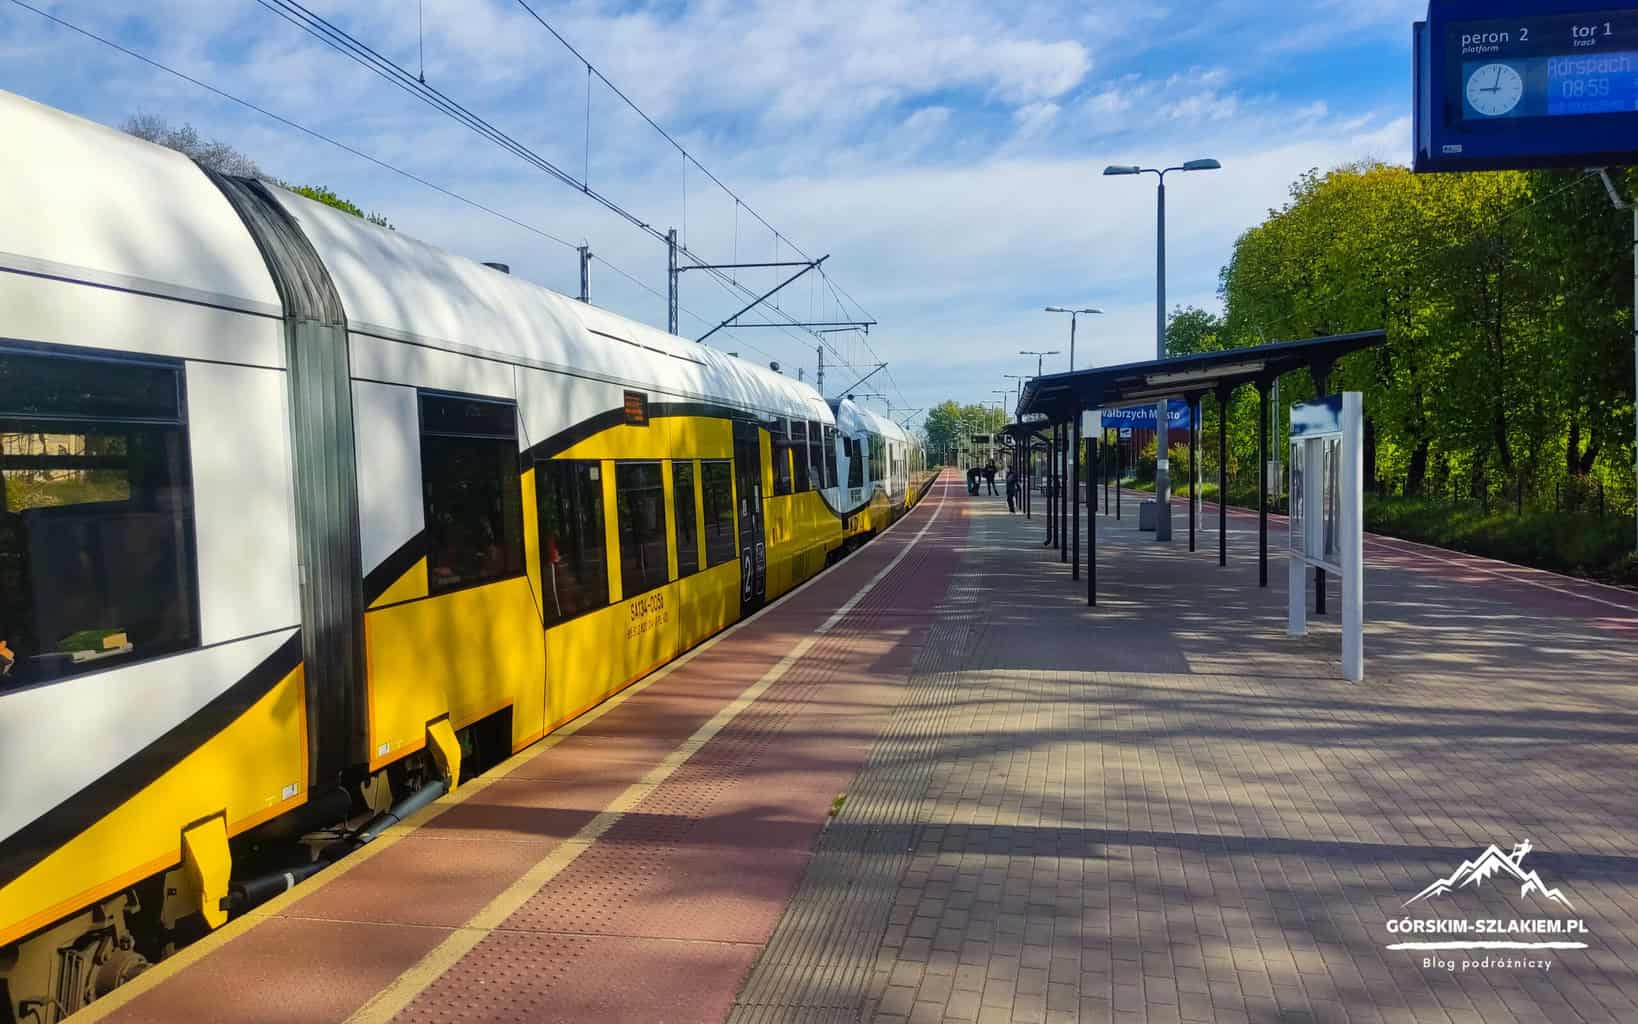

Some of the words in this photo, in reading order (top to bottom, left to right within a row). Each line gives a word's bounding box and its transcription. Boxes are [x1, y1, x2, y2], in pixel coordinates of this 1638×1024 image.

[1461, 31, 1509, 47] peron
[1519, 27, 1529, 41] 2
[1572, 24, 1597, 38] tor
[1603, 22, 1612, 36] 1
[1461, 45, 1499, 55] platform
